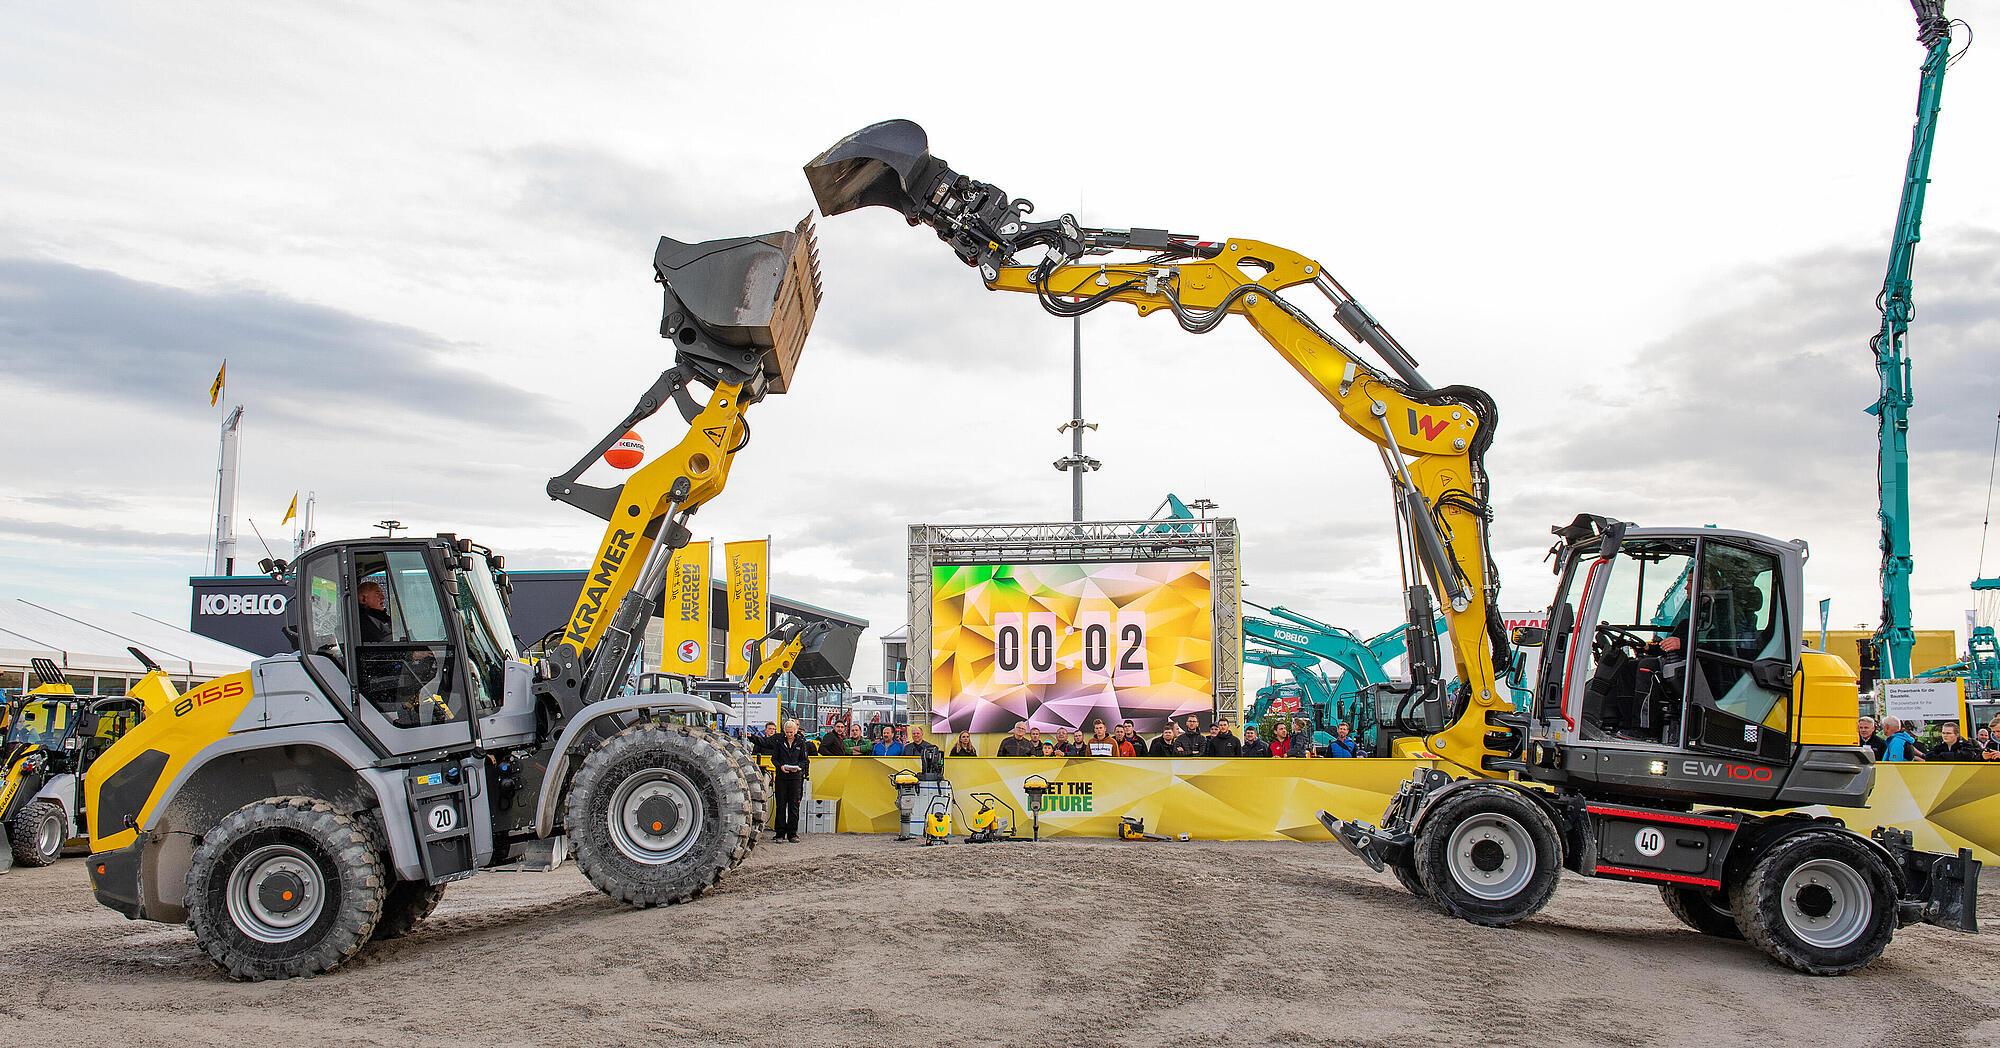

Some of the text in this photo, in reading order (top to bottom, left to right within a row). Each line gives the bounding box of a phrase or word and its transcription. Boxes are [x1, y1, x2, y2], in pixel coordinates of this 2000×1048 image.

[567, 528, 636, 644] KRAMER
[200, 594, 287, 615] KOBELCO
[1274, 624, 1308, 644] KOBELCO
[174, 682, 244, 718] 8155
[1067, 782, 1093, 794] THE
[1028, 796, 1093, 812] UTURE
[434, 809, 452, 828] 20
[1641, 832, 1658, 850] 40
